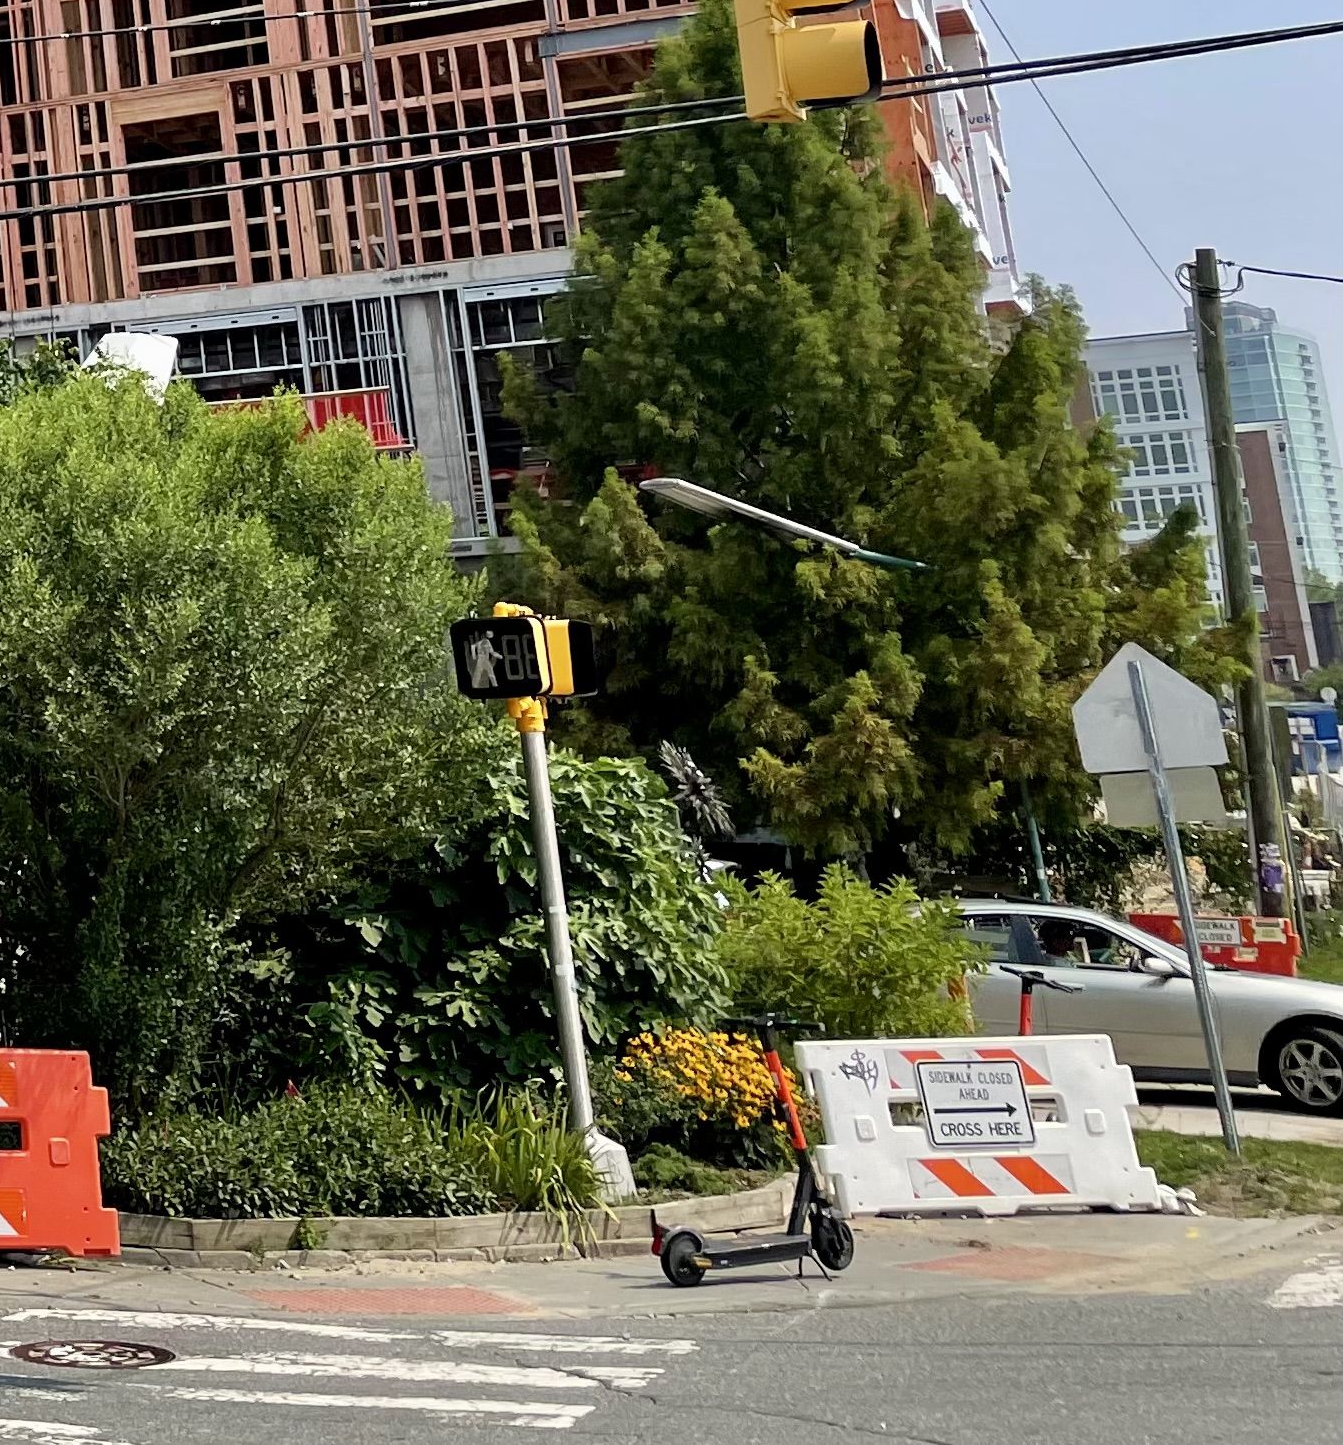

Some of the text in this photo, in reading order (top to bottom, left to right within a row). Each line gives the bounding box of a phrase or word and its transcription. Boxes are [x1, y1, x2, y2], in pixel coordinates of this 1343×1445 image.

[968, 112, 991, 125] vek
[1199, 933, 1232, 942] CLOSED
[929, 1071, 1013, 1084] SIDEWALK CLOSED
[959, 1088, 989, 1100] AHEAD
[941, 1122, 1023, 1136] CROSS HERE
